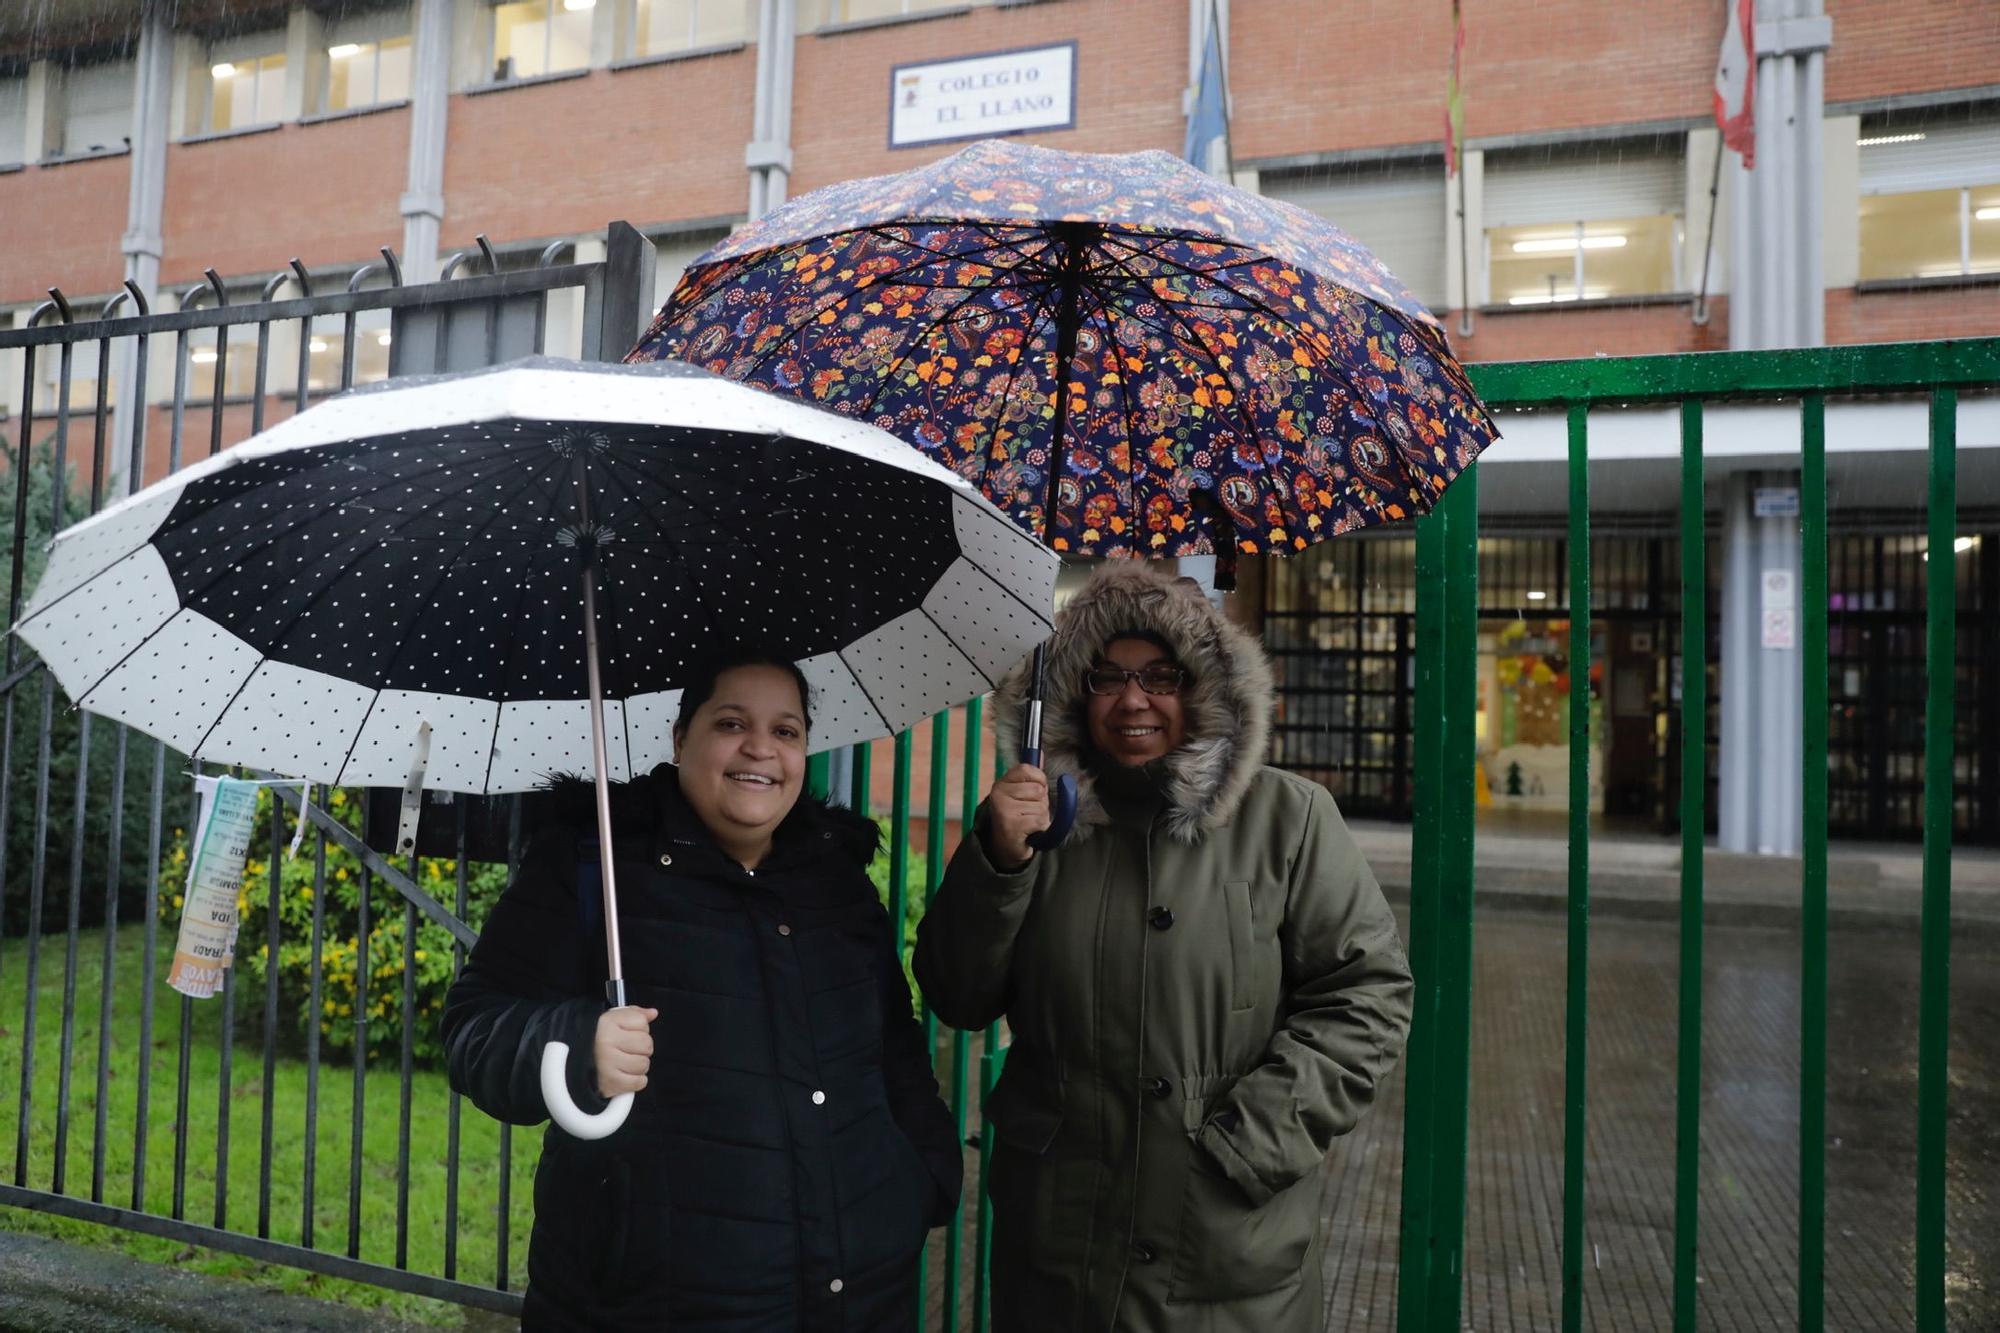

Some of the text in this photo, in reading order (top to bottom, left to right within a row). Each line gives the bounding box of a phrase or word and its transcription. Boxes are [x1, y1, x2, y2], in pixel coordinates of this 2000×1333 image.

[938, 67, 1040, 94] COLEGIO
[937, 95, 1054, 124] EL LLANO
